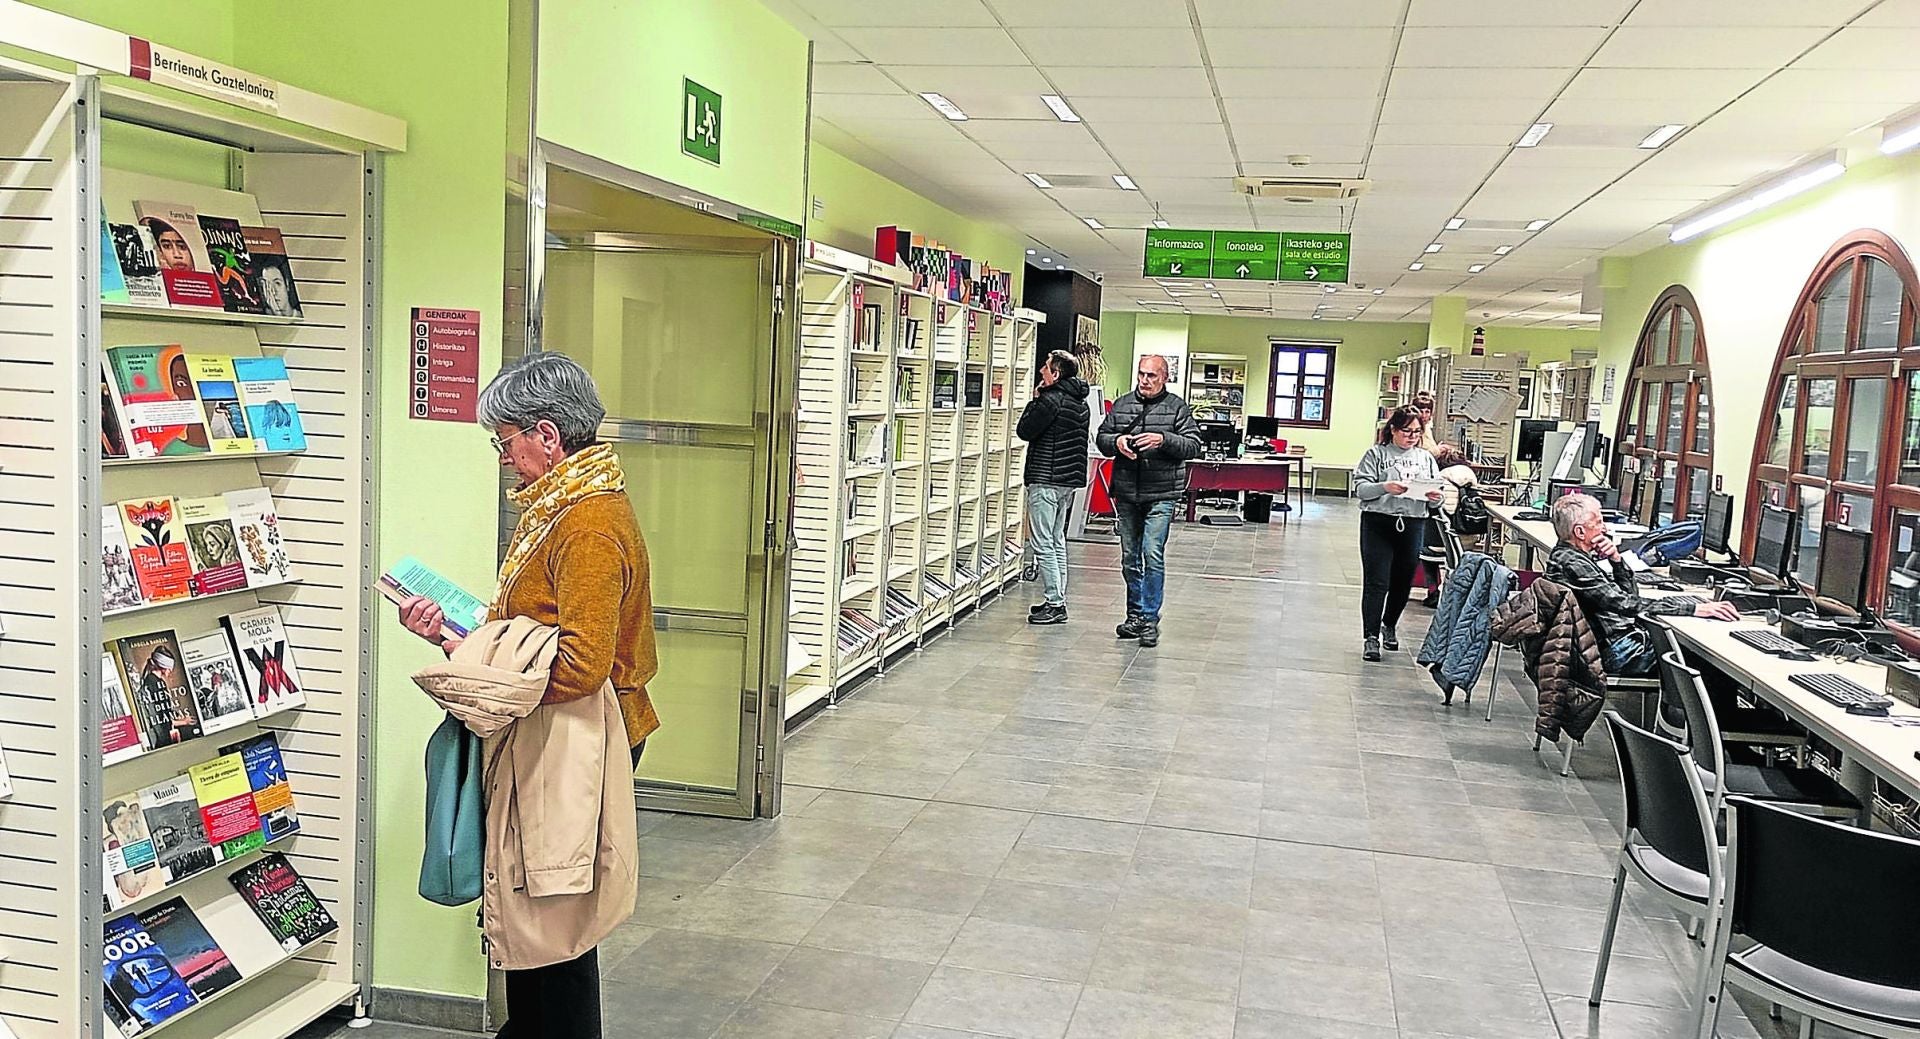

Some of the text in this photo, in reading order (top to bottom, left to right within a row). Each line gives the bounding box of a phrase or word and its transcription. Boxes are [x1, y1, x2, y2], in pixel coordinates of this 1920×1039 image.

[154, 52, 275, 100] Berrienak Gaztelaniaz
[1154, 239, 1204, 249] informazioa
[1226, 241, 1264, 251] fonoteka
[1286, 239, 1344, 251] ikasteko gela
[1285, 251, 1341, 260] sala de estudio
[854, 285, 862, 295] H
[425, 311, 467, 320] GENEROAK
[433, 327, 476, 337] Autobiografia
[432, 343, 466, 352] Historikoa
[432, 359, 454, 368] Intriga
[432, 374, 476, 384] Erromantikoa
[432, 390, 460, 399] Terrorea
[431, 406, 458, 414] Umorea
[1772, 490, 1779, 504] 4
[1840, 506, 1848, 523] 5
[240, 616, 275, 631] CARMEN
[247, 625, 273, 638] MOLA
[150, 708, 190, 726] LLAMAS
